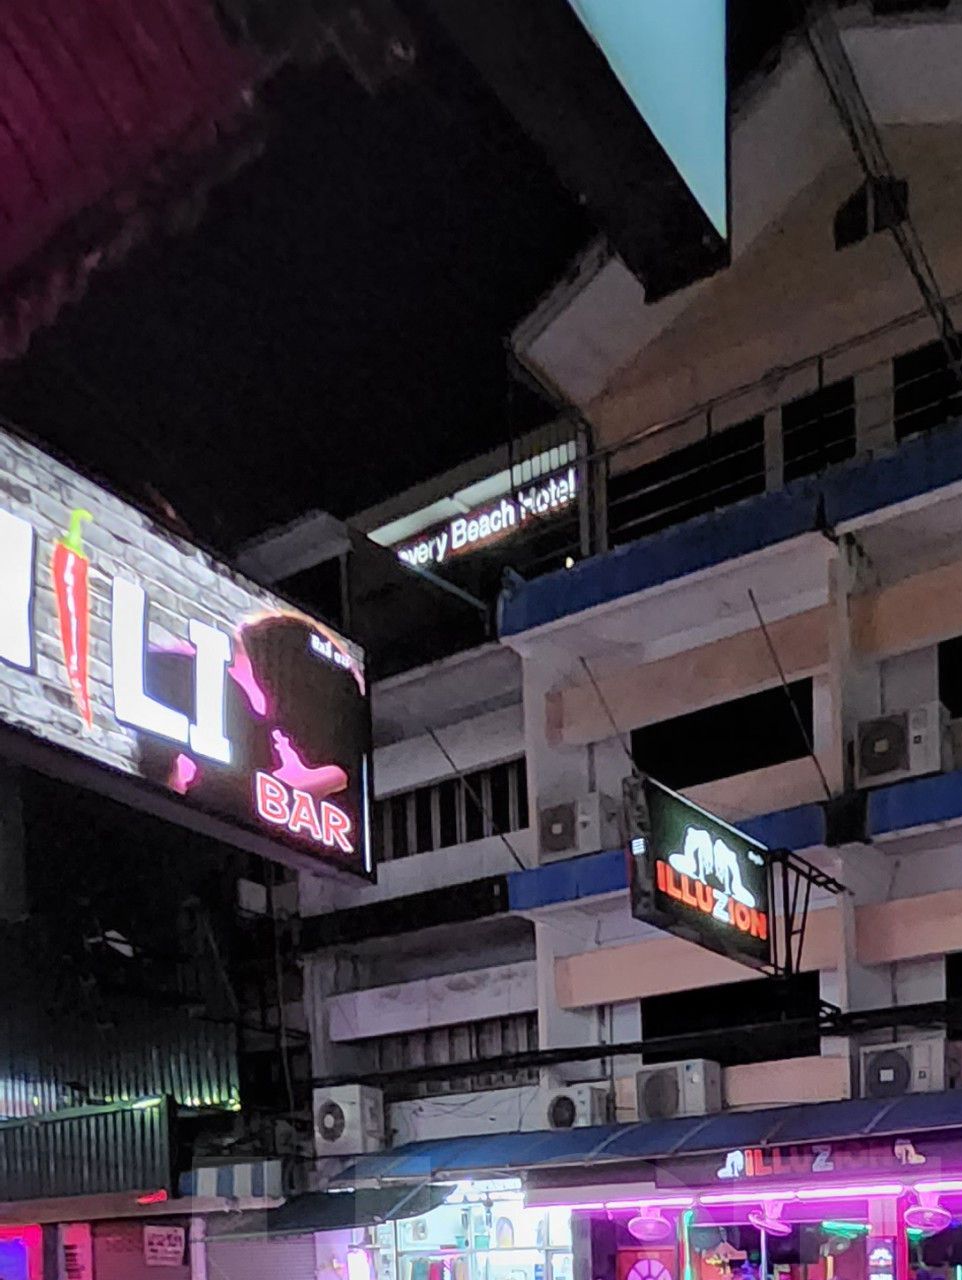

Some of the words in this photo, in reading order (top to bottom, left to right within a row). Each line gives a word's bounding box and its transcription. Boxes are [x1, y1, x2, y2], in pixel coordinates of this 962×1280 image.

[450, 499, 515, 549] Beach
[518, 467, 576, 519] Hotel
[255, 771, 353, 853] BAR
[656, 859, 768, 940] ILLUZION
